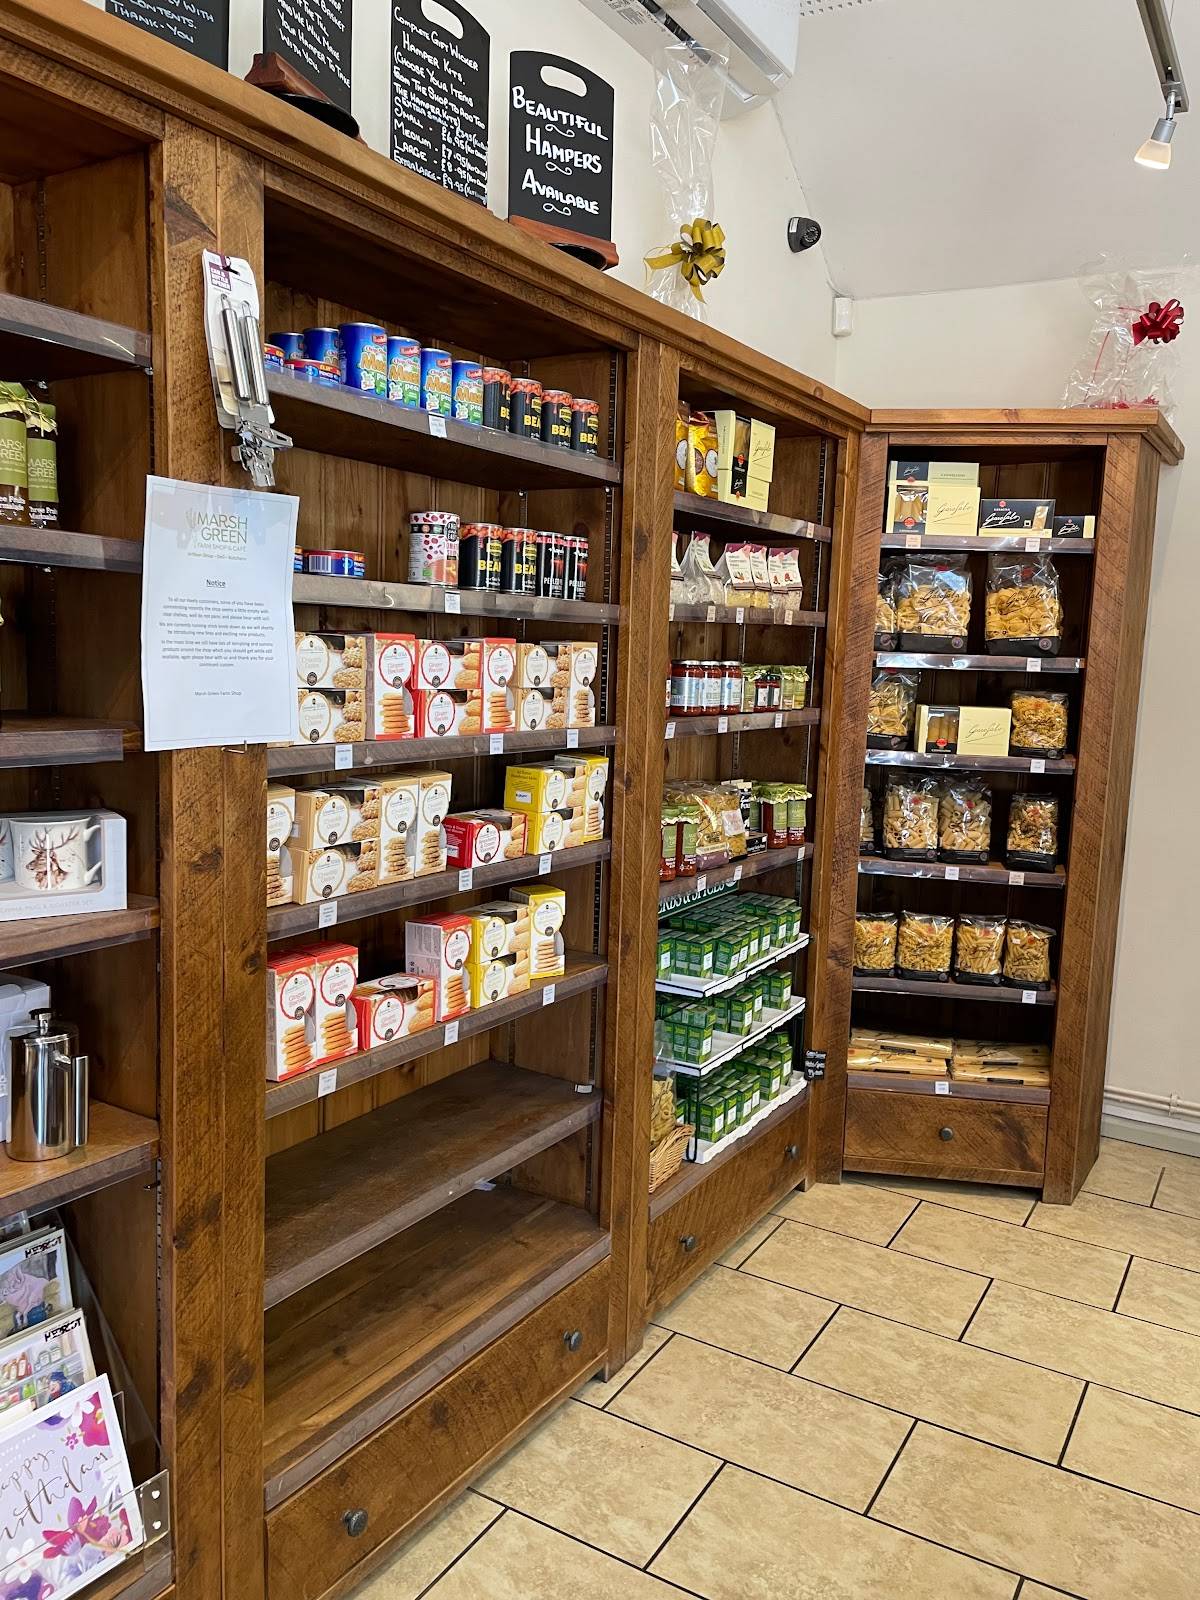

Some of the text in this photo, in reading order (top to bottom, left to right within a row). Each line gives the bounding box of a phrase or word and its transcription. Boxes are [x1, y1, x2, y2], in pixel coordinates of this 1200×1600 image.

[511, 85, 609, 141] BEAUTIFUL
[525, 123, 602, 174] HAMPERS
[521, 168, 600, 215] AVAILABLE
[523, 415, 541, 428] BEA
[551, 424, 571, 438] BEA
[0, 439, 25, 451] ARSH
[579, 432, 598, 445] BEA
[0, 449, 26, 462] REEN
[197, 511, 248, 530] MARSH
[201, 527, 247, 544] GREEN
[479, 559, 501, 574] BEA
[514, 563, 536, 576] BEA
[206, 579, 226, 588] Notice
[0, 1449, 55, 1498] appy
